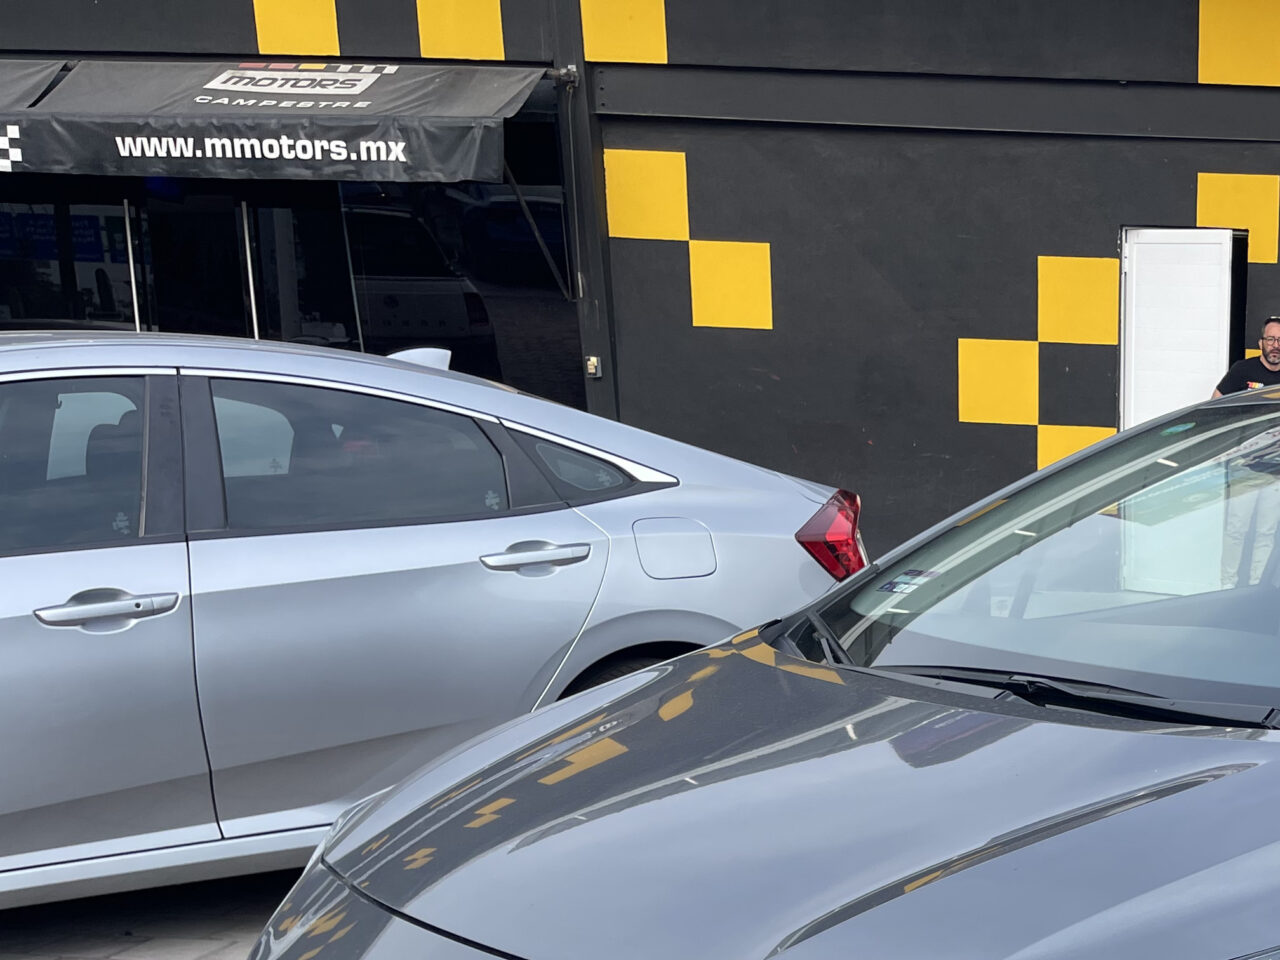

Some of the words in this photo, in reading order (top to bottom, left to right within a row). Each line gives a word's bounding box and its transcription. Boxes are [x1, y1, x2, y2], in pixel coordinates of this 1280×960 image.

[221, 75, 362, 90] MOTORS
[193, 95, 372, 108] CAMPESTRE
[114, 134, 407, 162] www.mmotors.mx
